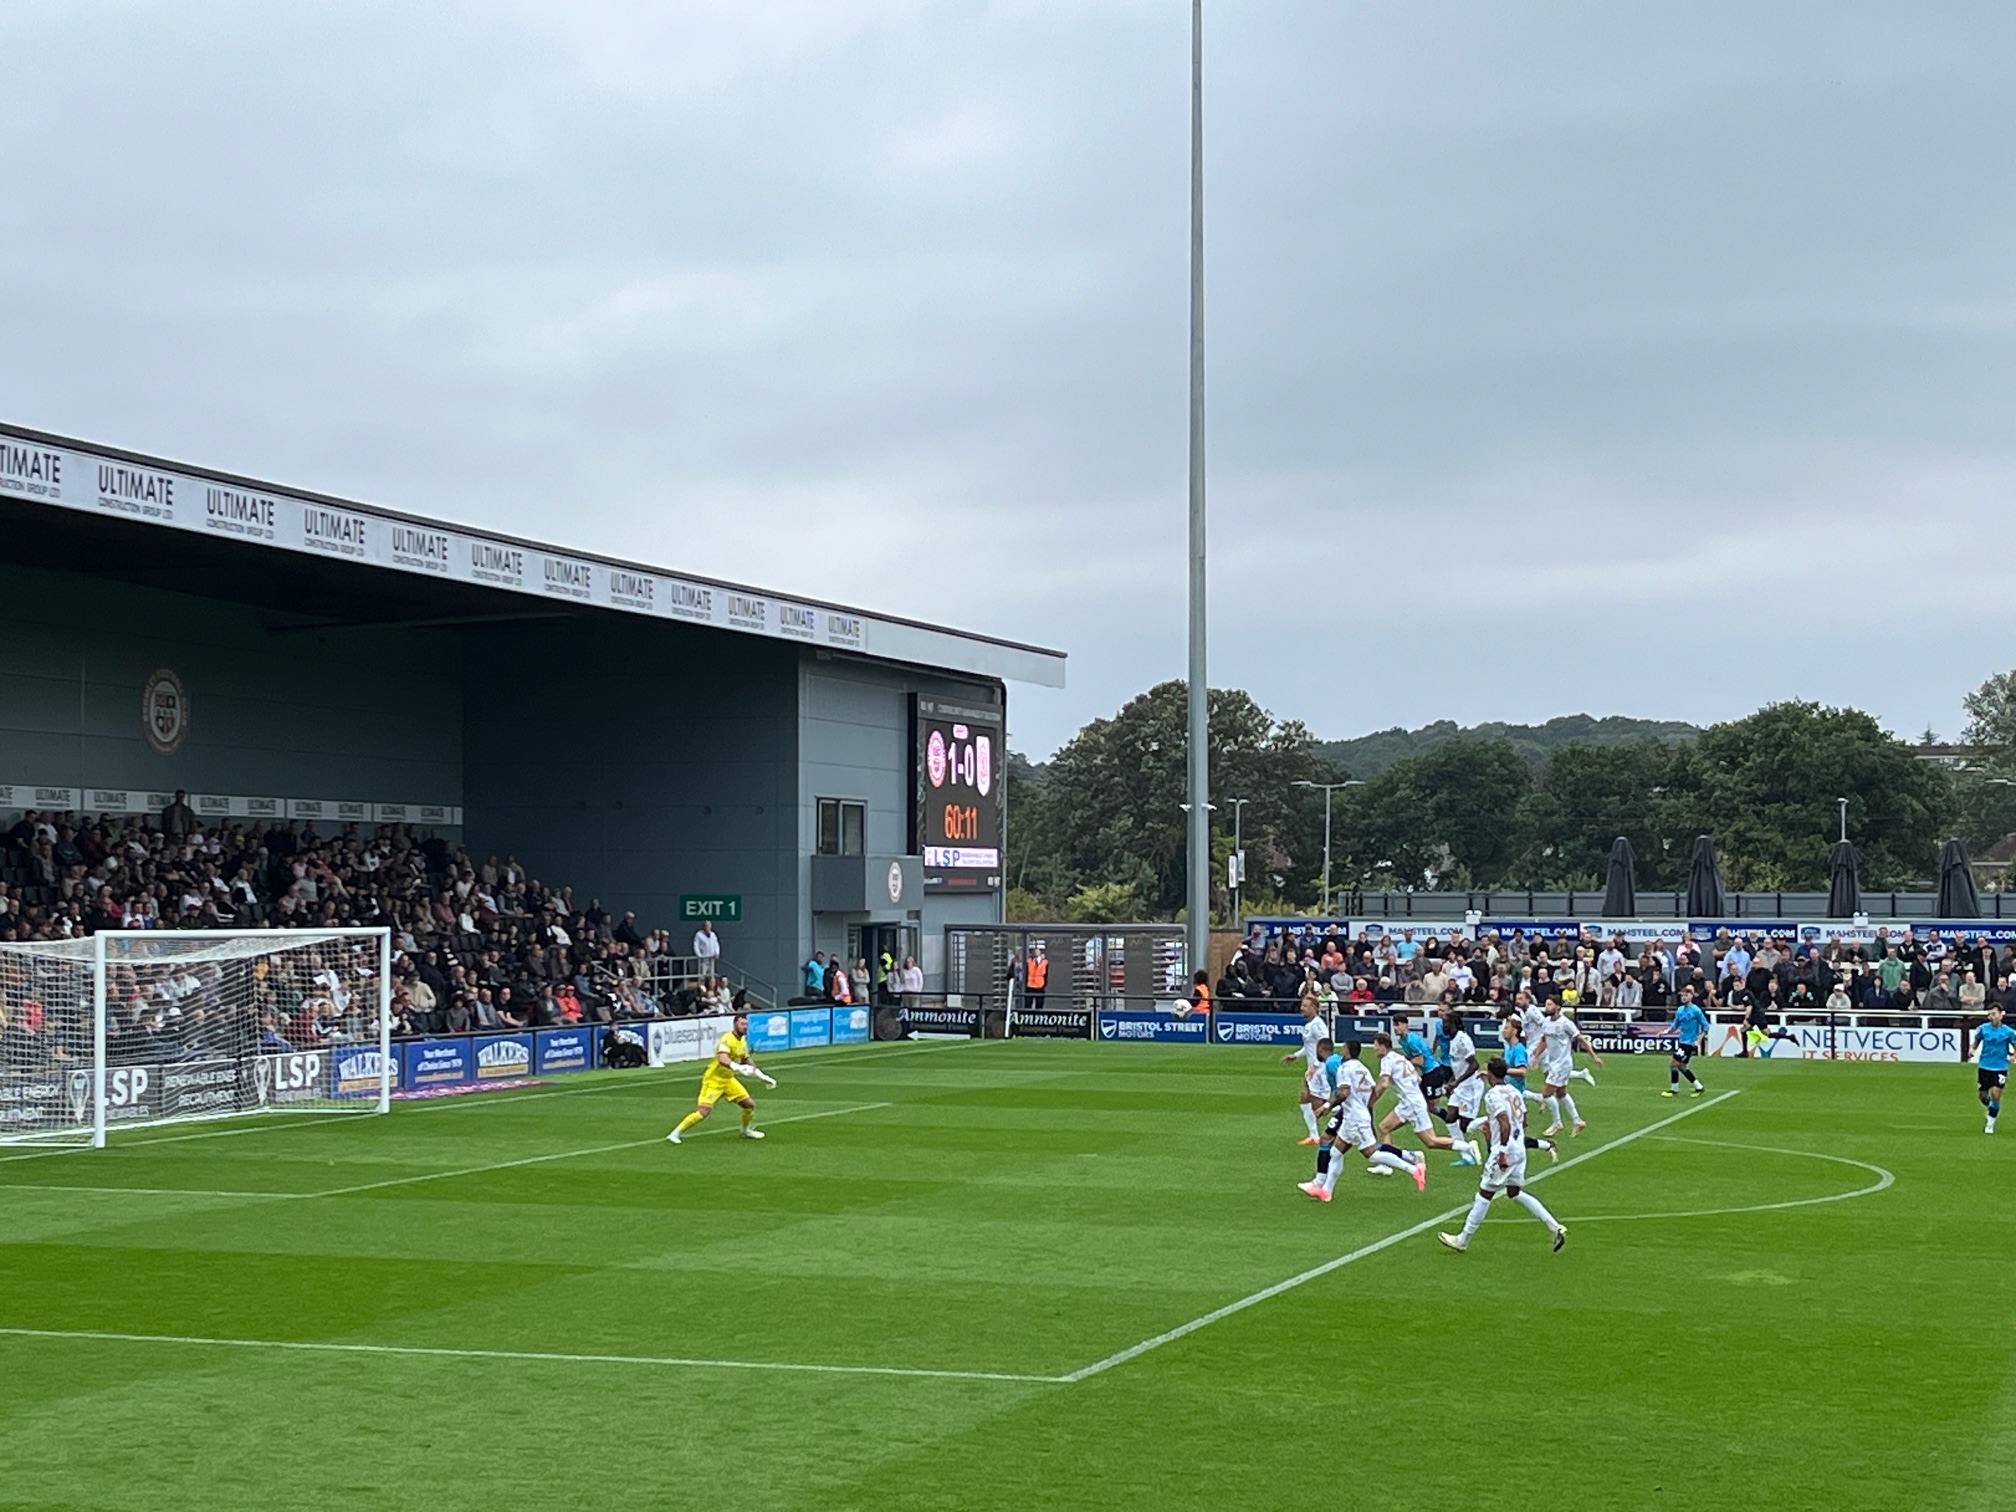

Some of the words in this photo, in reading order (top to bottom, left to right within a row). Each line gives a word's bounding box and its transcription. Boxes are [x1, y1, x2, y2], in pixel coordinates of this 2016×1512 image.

[98, 465, 173, 506] ULTIMATE
[207, 488, 274, 526] ULTIMATE
[304, 508, 365, 544] ULTIMATE
[392, 527, 448, 560] ULTIMATE
[472, 543, 522, 575] ULTIMATE
[544, 559, 591, 587] ULTIMATE
[610, 571, 653, 600] ULTIMATE
[671, 583, 712, 611] ULTIMATE
[35, 788, 70, 800] ULTIMATE
[94, 791, 127, 803] ULTIMATE
[944, 804, 978, 840] 60:11
[934, 849, 960, 866] LSP
[686, 901, 724, 916] EXIT
[728, 901, 735, 916] 1
[896, 1008, 977, 1024] Ammonite
[1009, 1011, 1088, 1027] Ammonite
[1118, 1021, 1163, 1032] BRISTOL
[1164, 1022, 1205, 1033] STREET
[1235, 1023, 1281, 1035] BRISTOL
[1118, 1030, 1155, 1039] MOTORS
[1235, 1032, 1273, 1042] MOTORS
[1802, 1029, 1958, 1052] NETVECTOR
[339, 1052, 398, 1080] WALKES
[477, 1041, 529, 1067] WALKERS
[275, 1055, 320, 1090] LSP
[105, 1068, 148, 1106] SP
